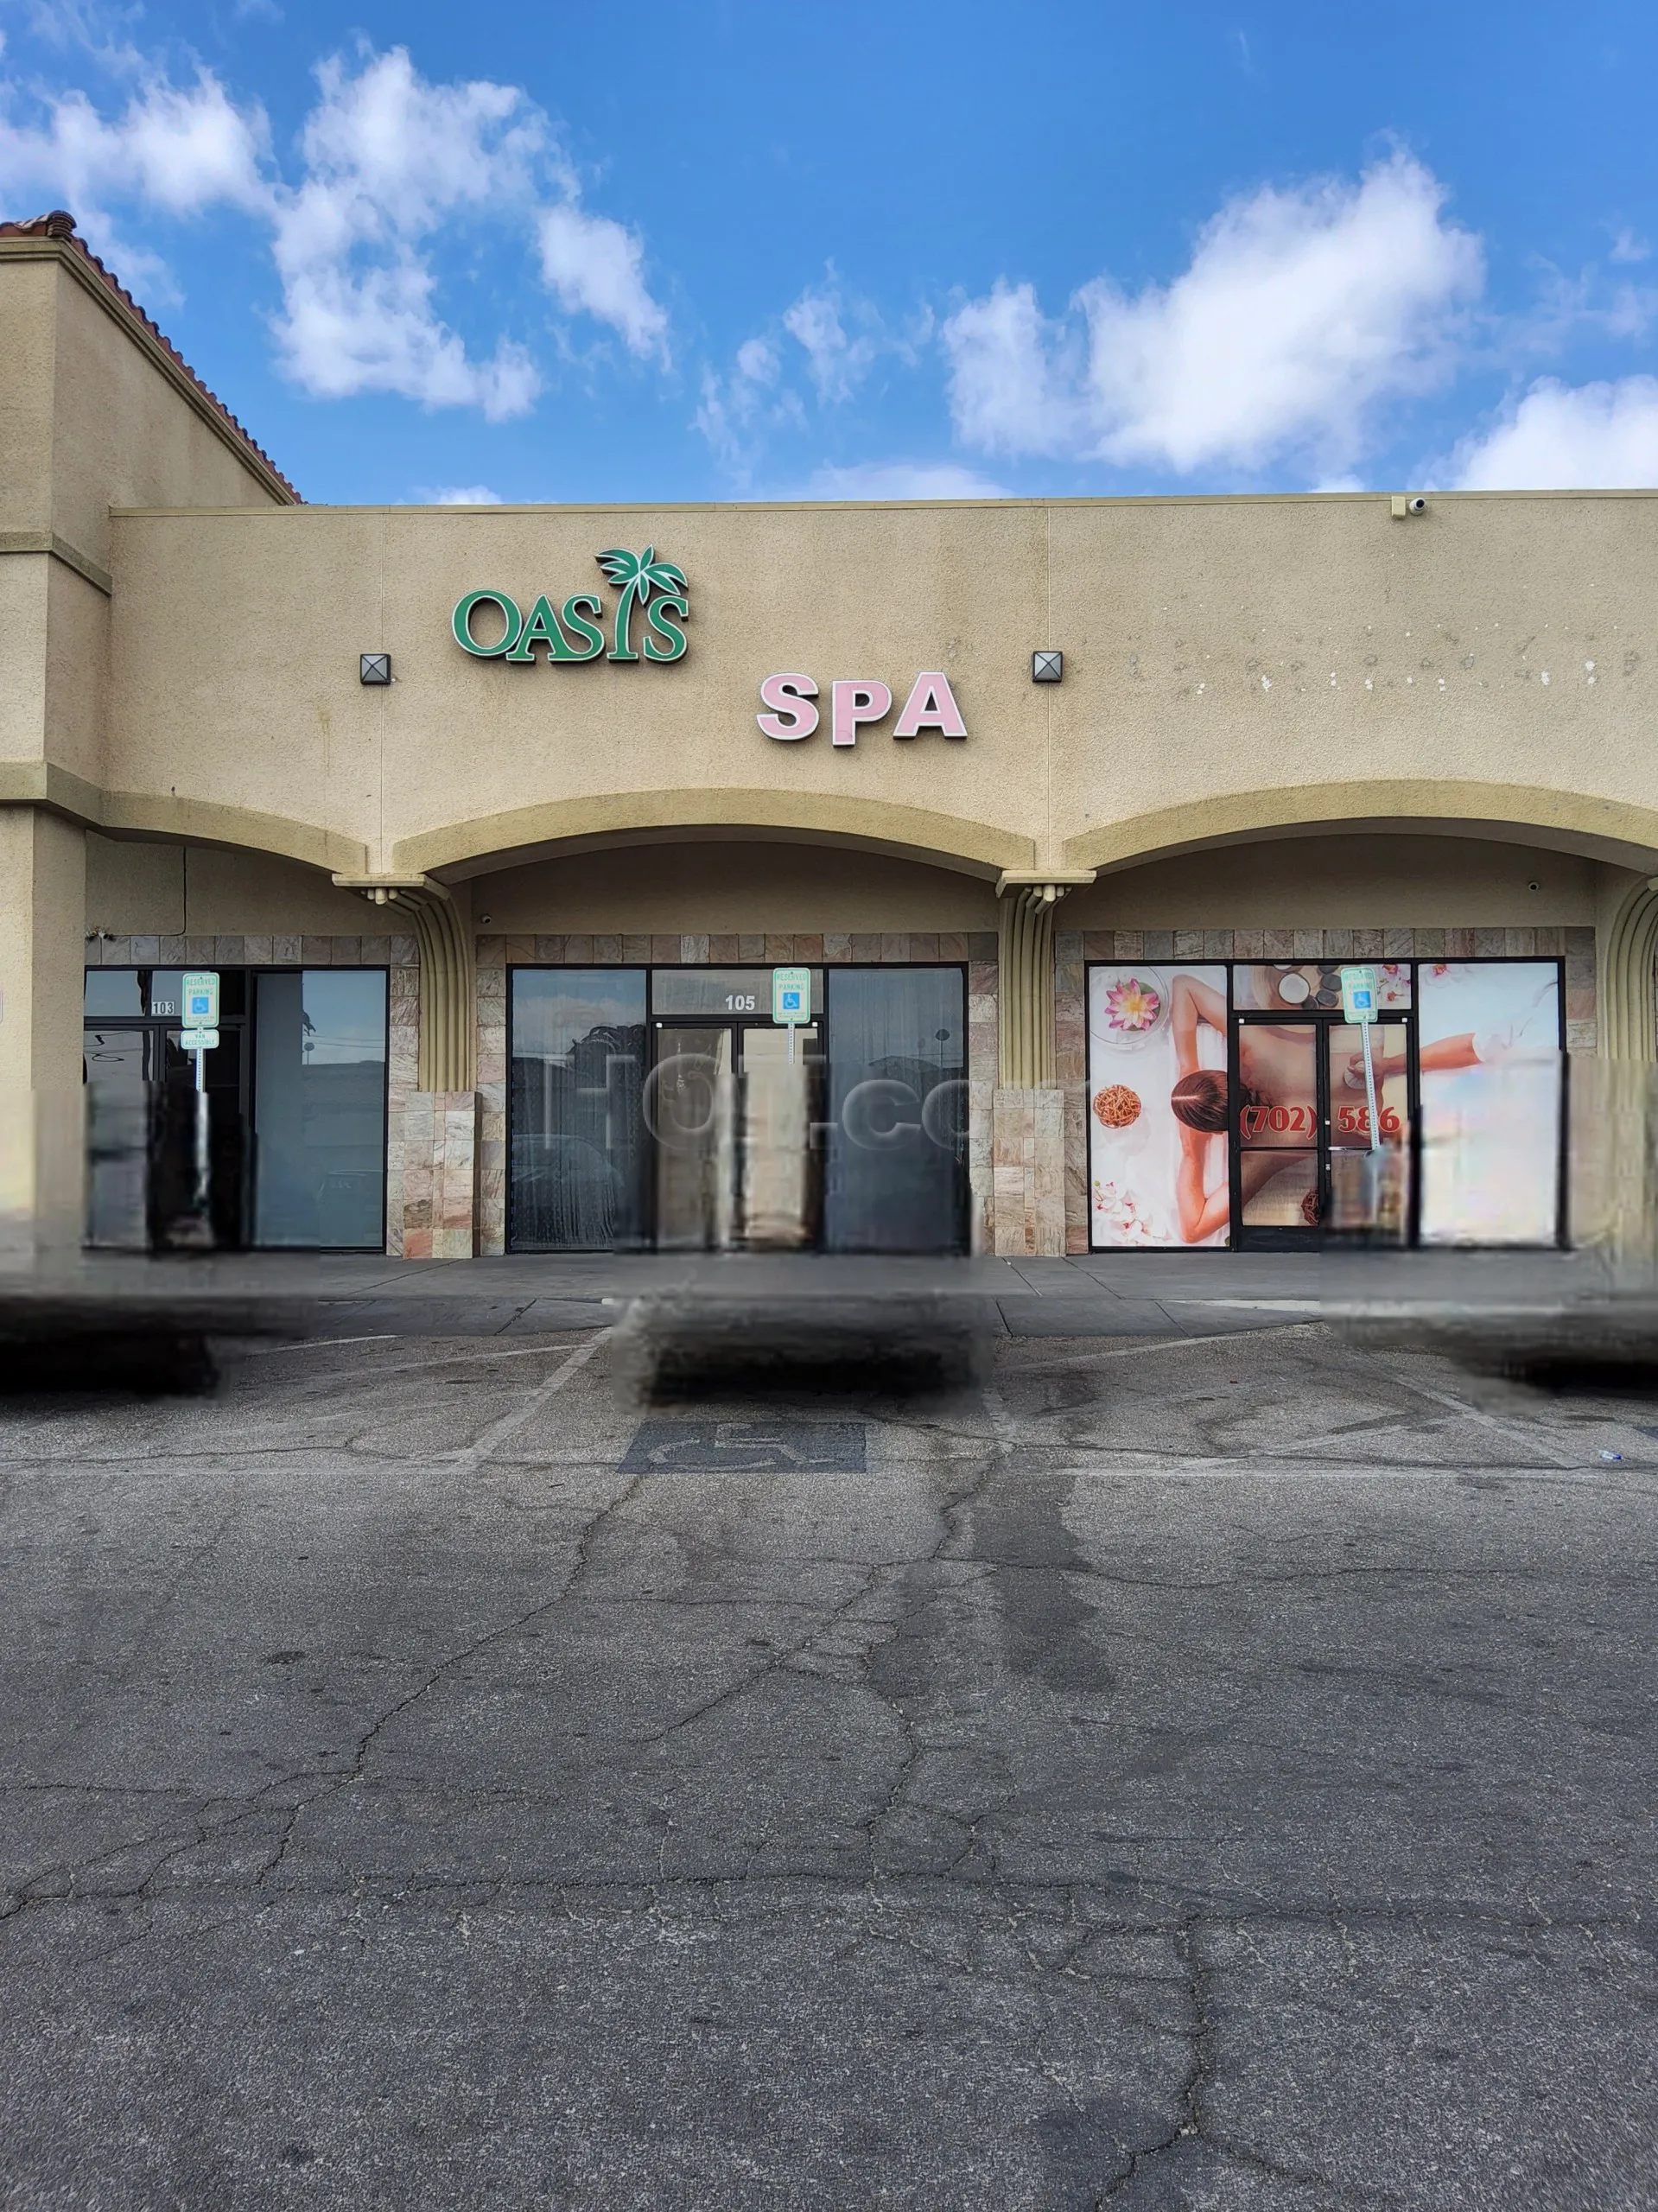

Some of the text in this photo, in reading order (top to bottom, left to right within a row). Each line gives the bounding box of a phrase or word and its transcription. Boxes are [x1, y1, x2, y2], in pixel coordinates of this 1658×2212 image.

[450, 550, 691, 664] OASIS
[757, 671, 968, 747] SPA
[153, 1002, 174, 1014] 103
[725, 995, 755, 1010] 105
[1240, 1104, 1317, 1140] (702)
